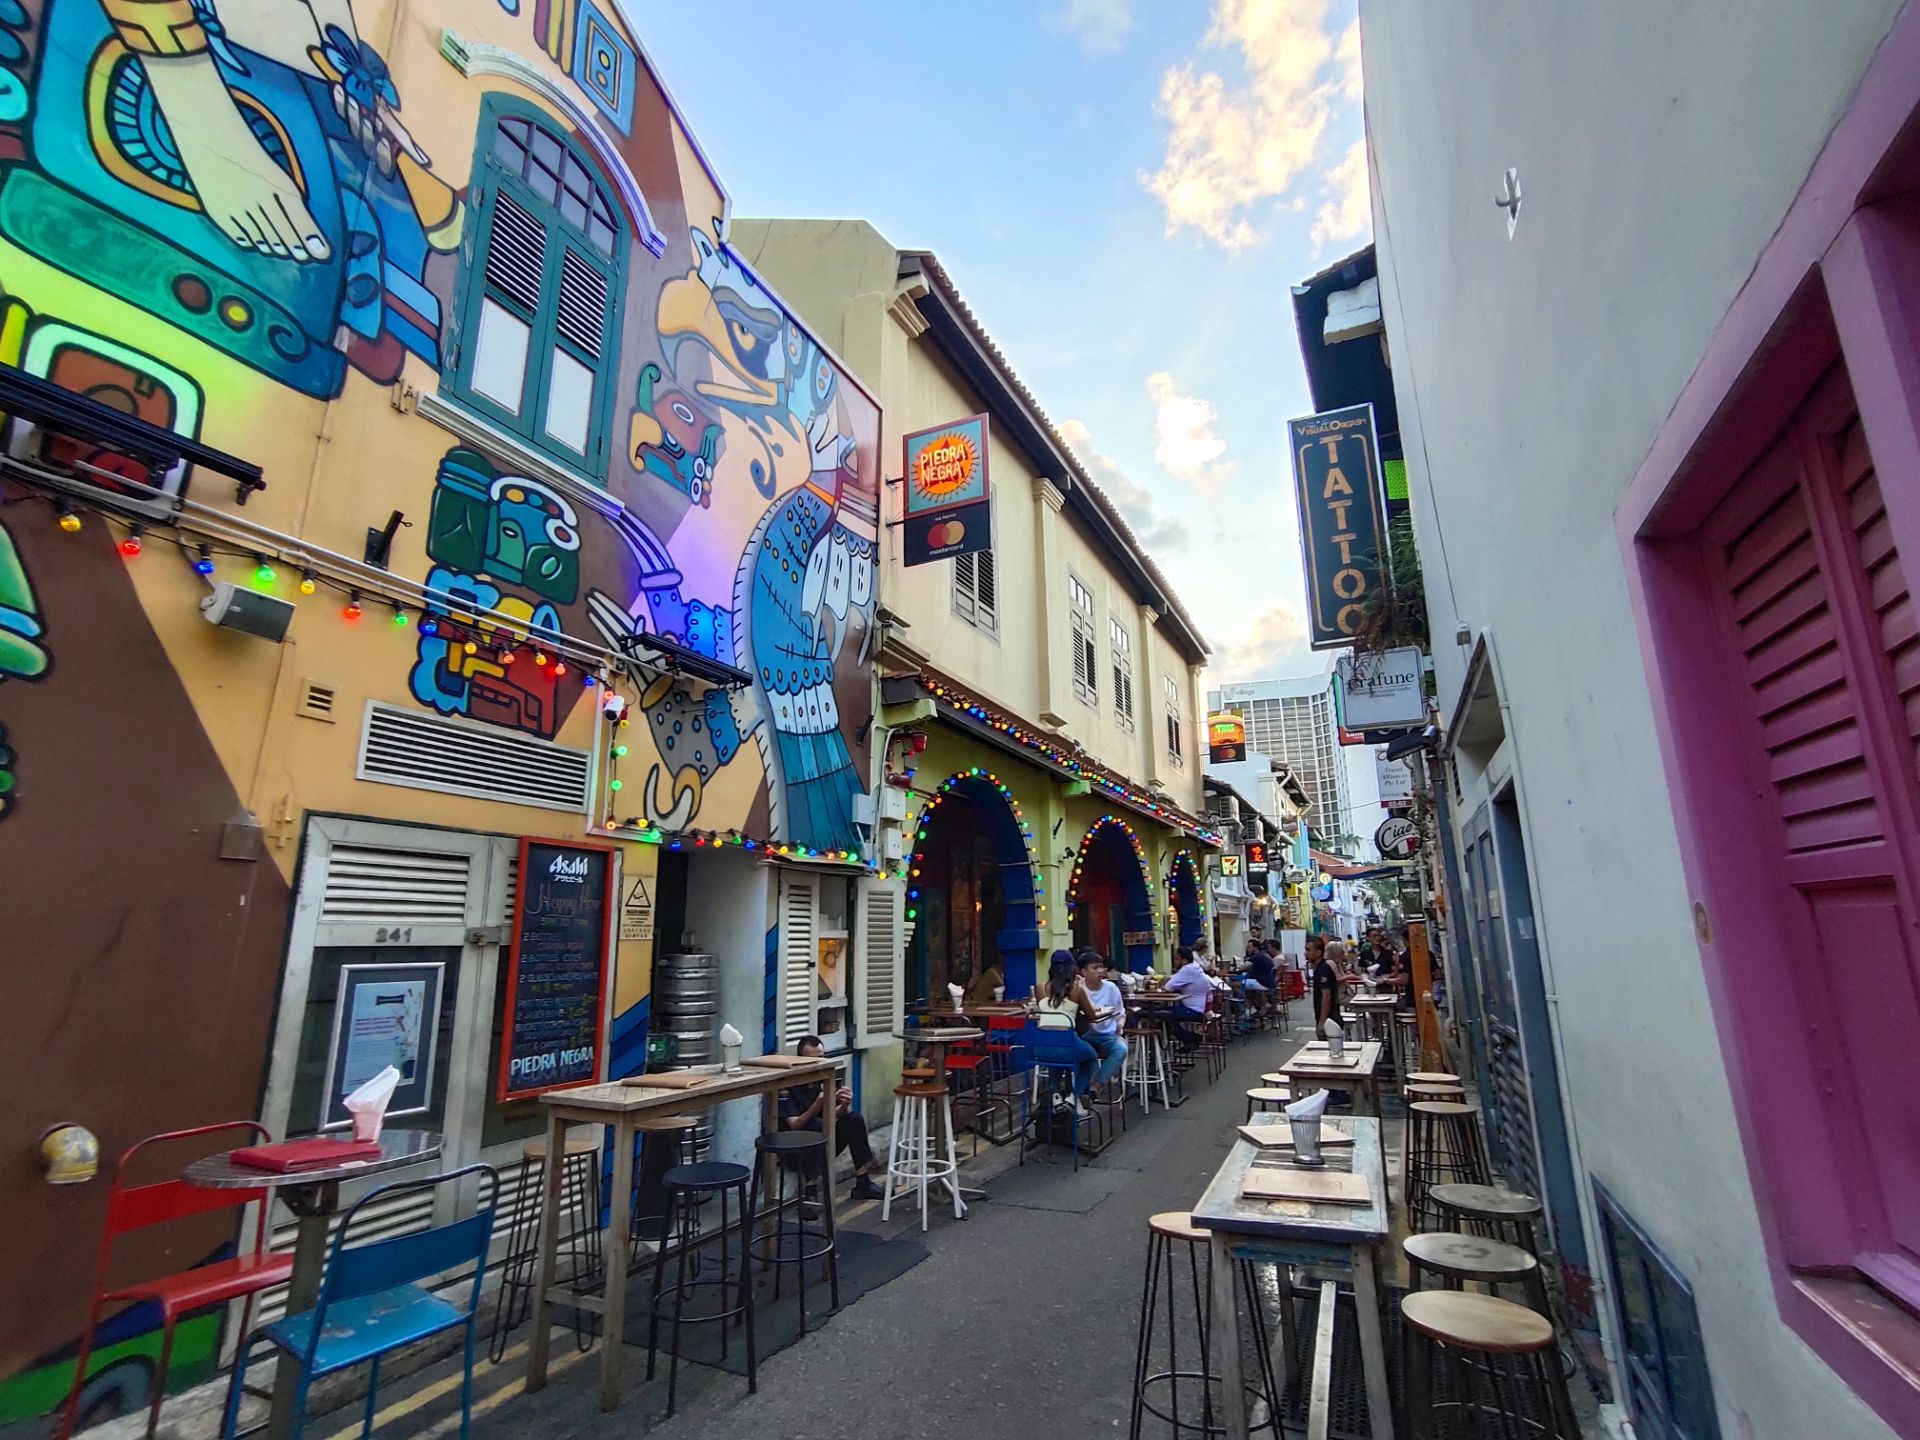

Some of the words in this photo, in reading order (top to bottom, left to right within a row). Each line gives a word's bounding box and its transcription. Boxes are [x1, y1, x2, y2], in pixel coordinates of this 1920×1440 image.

[920, 444, 967, 468] PIEDRA
[921, 462, 963, 485] NEGRA
[1319, 433, 1368, 635] TATTOO
[929, 543, 964, 555] mastercard
[1381, 823, 1414, 849] Ciao
[549, 854, 588, 876] Asahi
[375, 927, 413, 943] 241
[511, 1053, 556, 1075] PIEDRA
[560, 1046, 594, 1065] NEGRA
